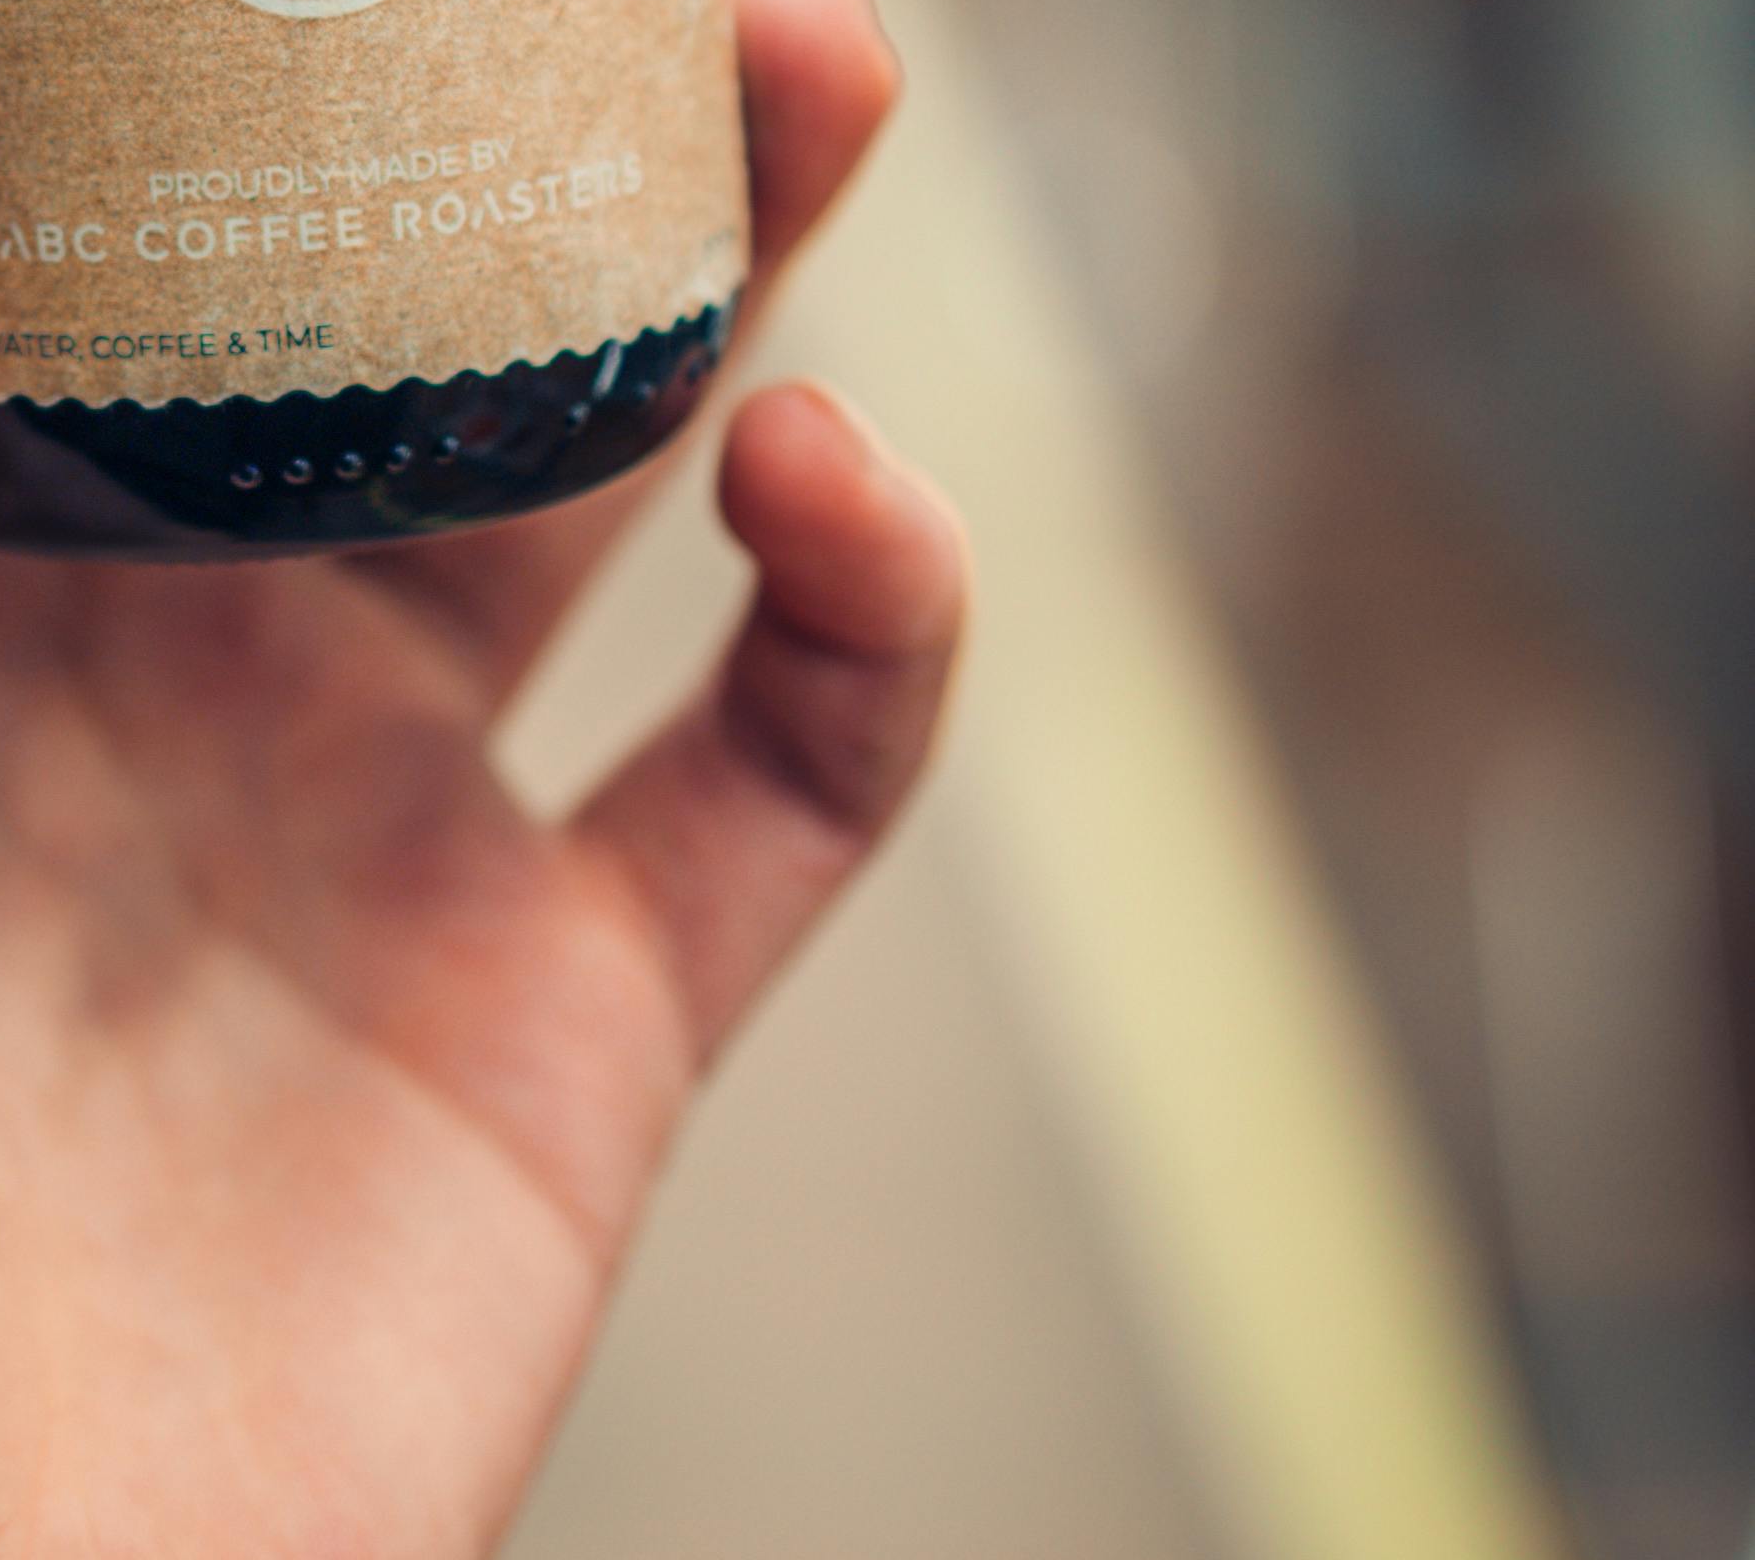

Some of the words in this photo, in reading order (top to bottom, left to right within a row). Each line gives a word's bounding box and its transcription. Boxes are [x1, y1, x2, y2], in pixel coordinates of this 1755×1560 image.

[148, 163, 331, 203] PROUDLY
[349, 144, 462, 194] MADE
[469, 135, 516, 173] BY
[0, 221, 107, 262] ABC
[135, 207, 366, 261] COFFEE
[391, 151, 643, 241] ROASTERS
[90, 333, 217, 360] COFFEE
[228, 332, 248, 355] &
[255, 323, 335, 353] TIME
